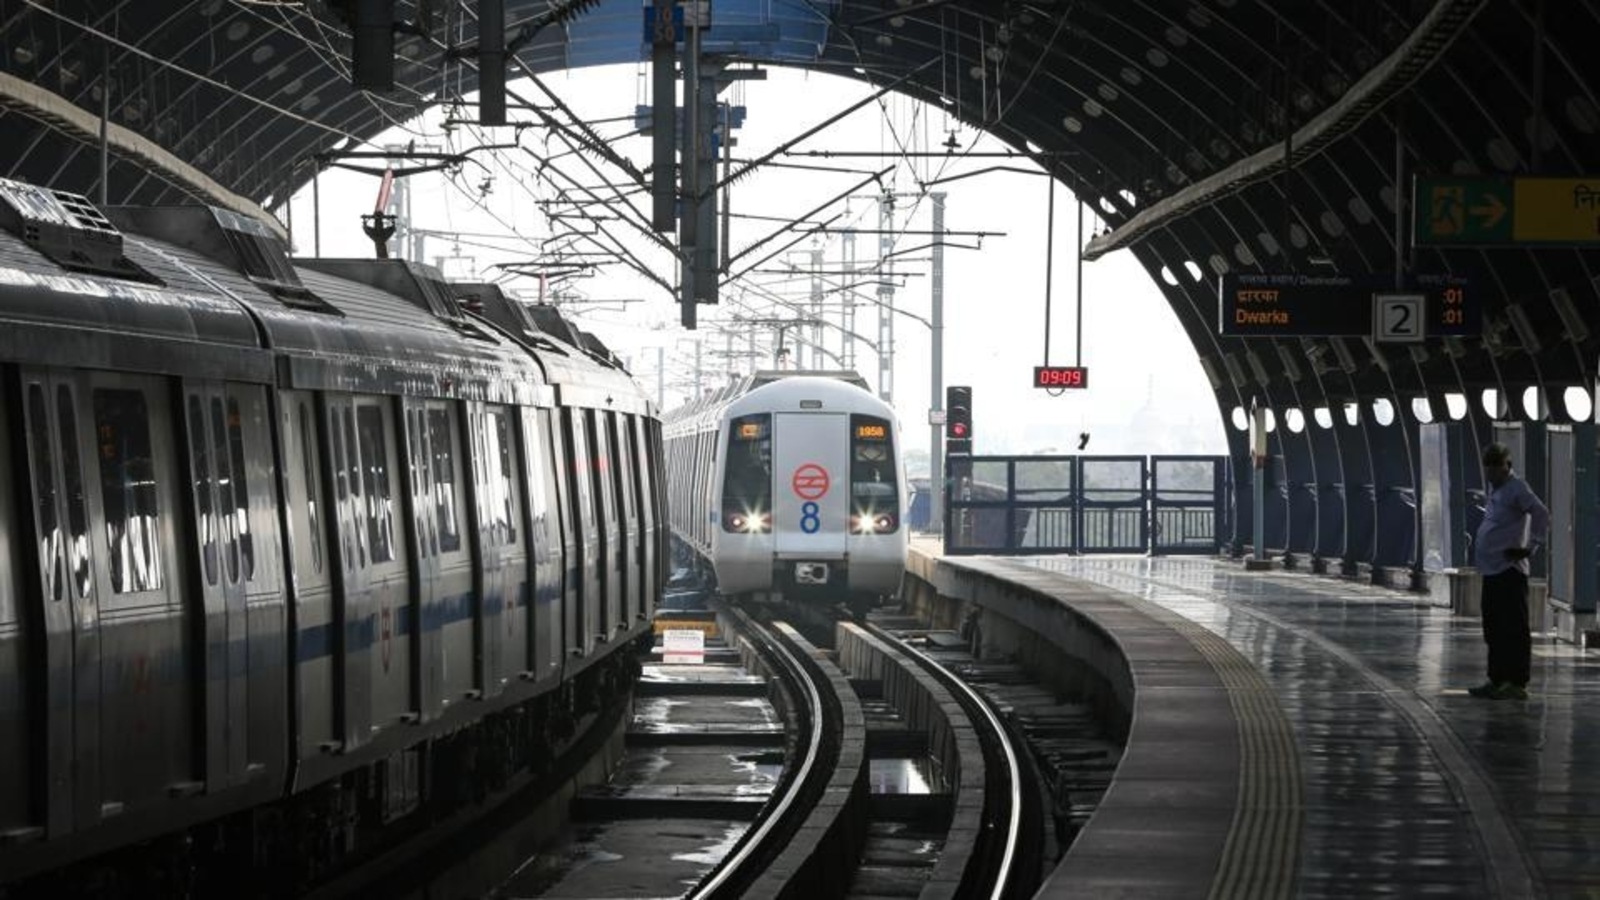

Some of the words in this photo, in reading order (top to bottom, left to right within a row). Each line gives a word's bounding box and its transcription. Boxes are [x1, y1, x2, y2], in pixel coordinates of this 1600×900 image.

[1236, 308, 1289, 323] Dwarka
[1391, 304, 1411, 333] 2
[1041, 370, 1080, 384] 09:09
[800, 501, 820, 534] 8
